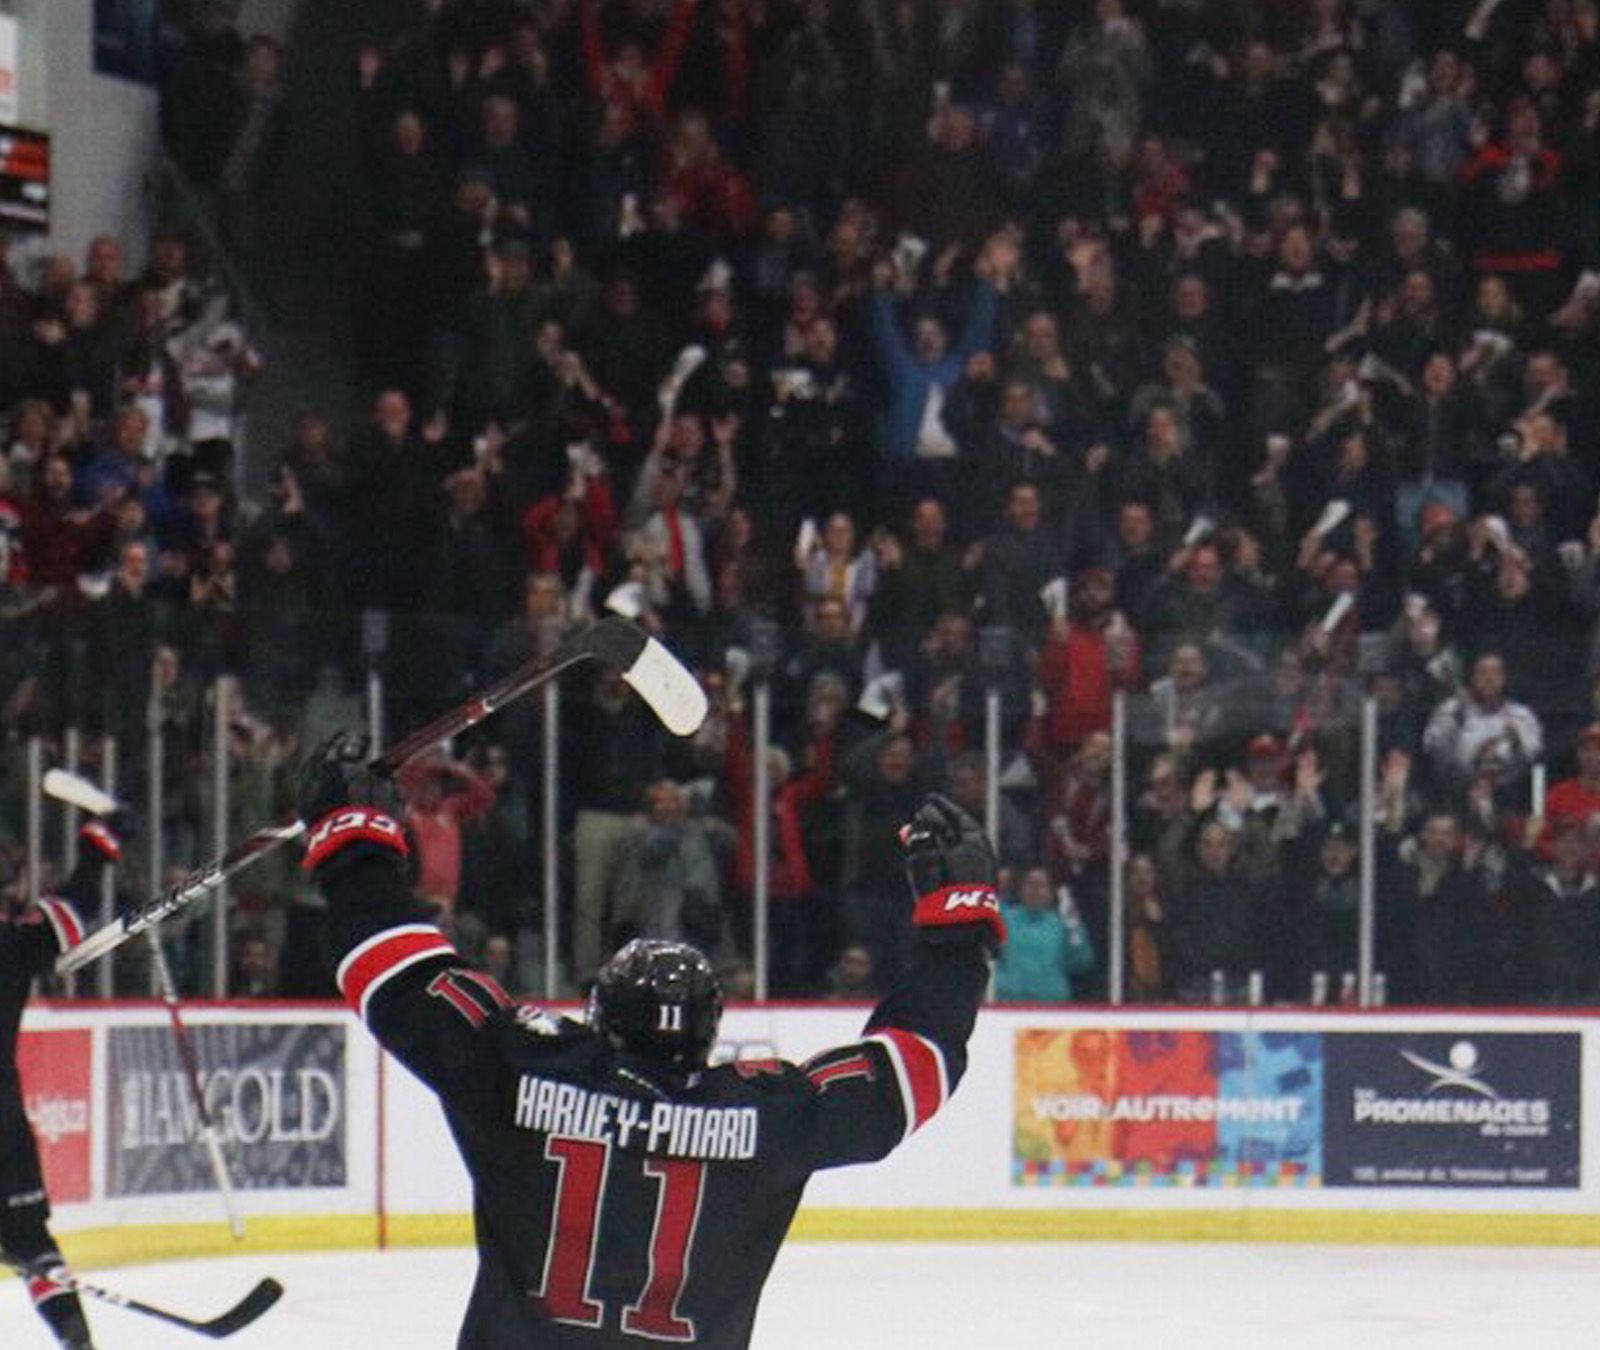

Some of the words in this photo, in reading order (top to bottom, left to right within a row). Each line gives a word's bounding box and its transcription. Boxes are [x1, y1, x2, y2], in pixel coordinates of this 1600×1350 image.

[657, 1003, 683, 1032] 11
[140, 1066, 338, 1147] IAMGOLD
[514, 1074, 758, 1160] HARVEY-PINARD
[1034, 1094, 1103, 1122] VOIR
[1353, 1098, 1549, 1124] PROMENADES
[533, 1133, 706, 1342] 11
